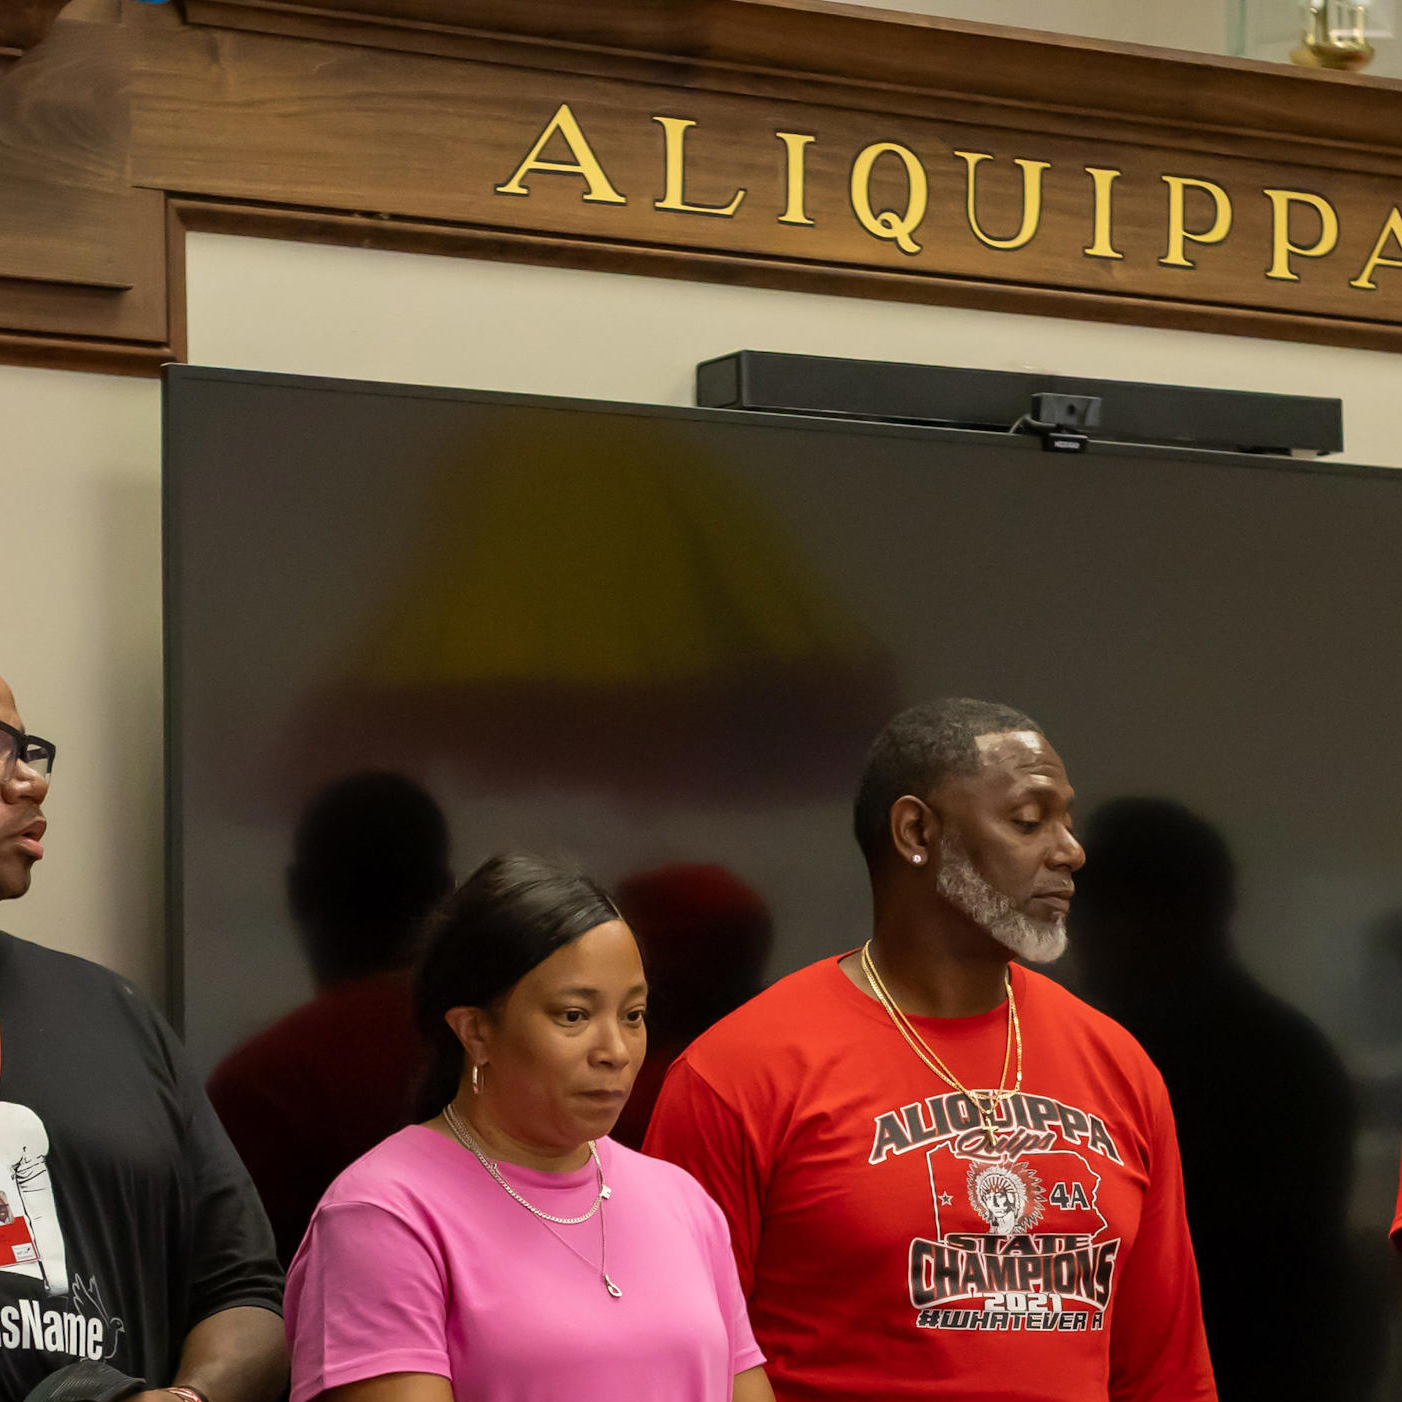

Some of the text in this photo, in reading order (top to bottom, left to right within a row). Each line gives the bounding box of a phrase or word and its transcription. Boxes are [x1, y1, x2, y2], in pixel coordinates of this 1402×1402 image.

[868, 1089, 1125, 1166] ALIQUIPPA
[954, 1126, 1058, 1165] Quips
[1049, 1181, 1091, 1211] 4A
[944, 1233, 1092, 1256] STATE
[908, 1236, 1121, 1312] CHAMPIONS
[984, 1292, 1063, 1313] 2021
